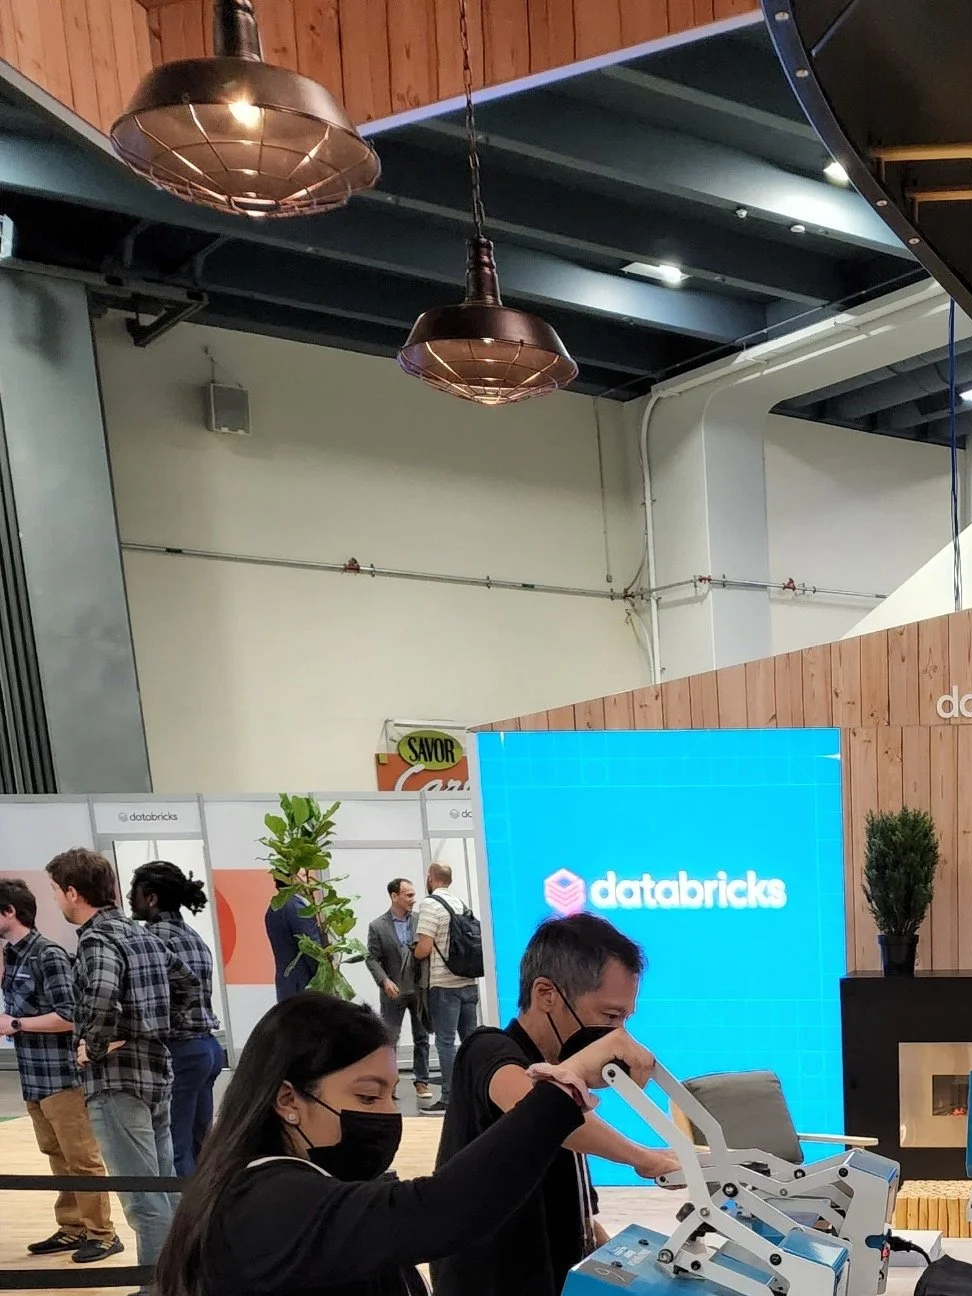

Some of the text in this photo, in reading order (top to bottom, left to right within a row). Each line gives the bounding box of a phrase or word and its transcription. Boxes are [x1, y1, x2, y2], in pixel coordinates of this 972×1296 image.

[408, 737, 456, 763] SAVOR
[129, 812, 178, 821] databricks
[590, 870, 788, 909] databricks
